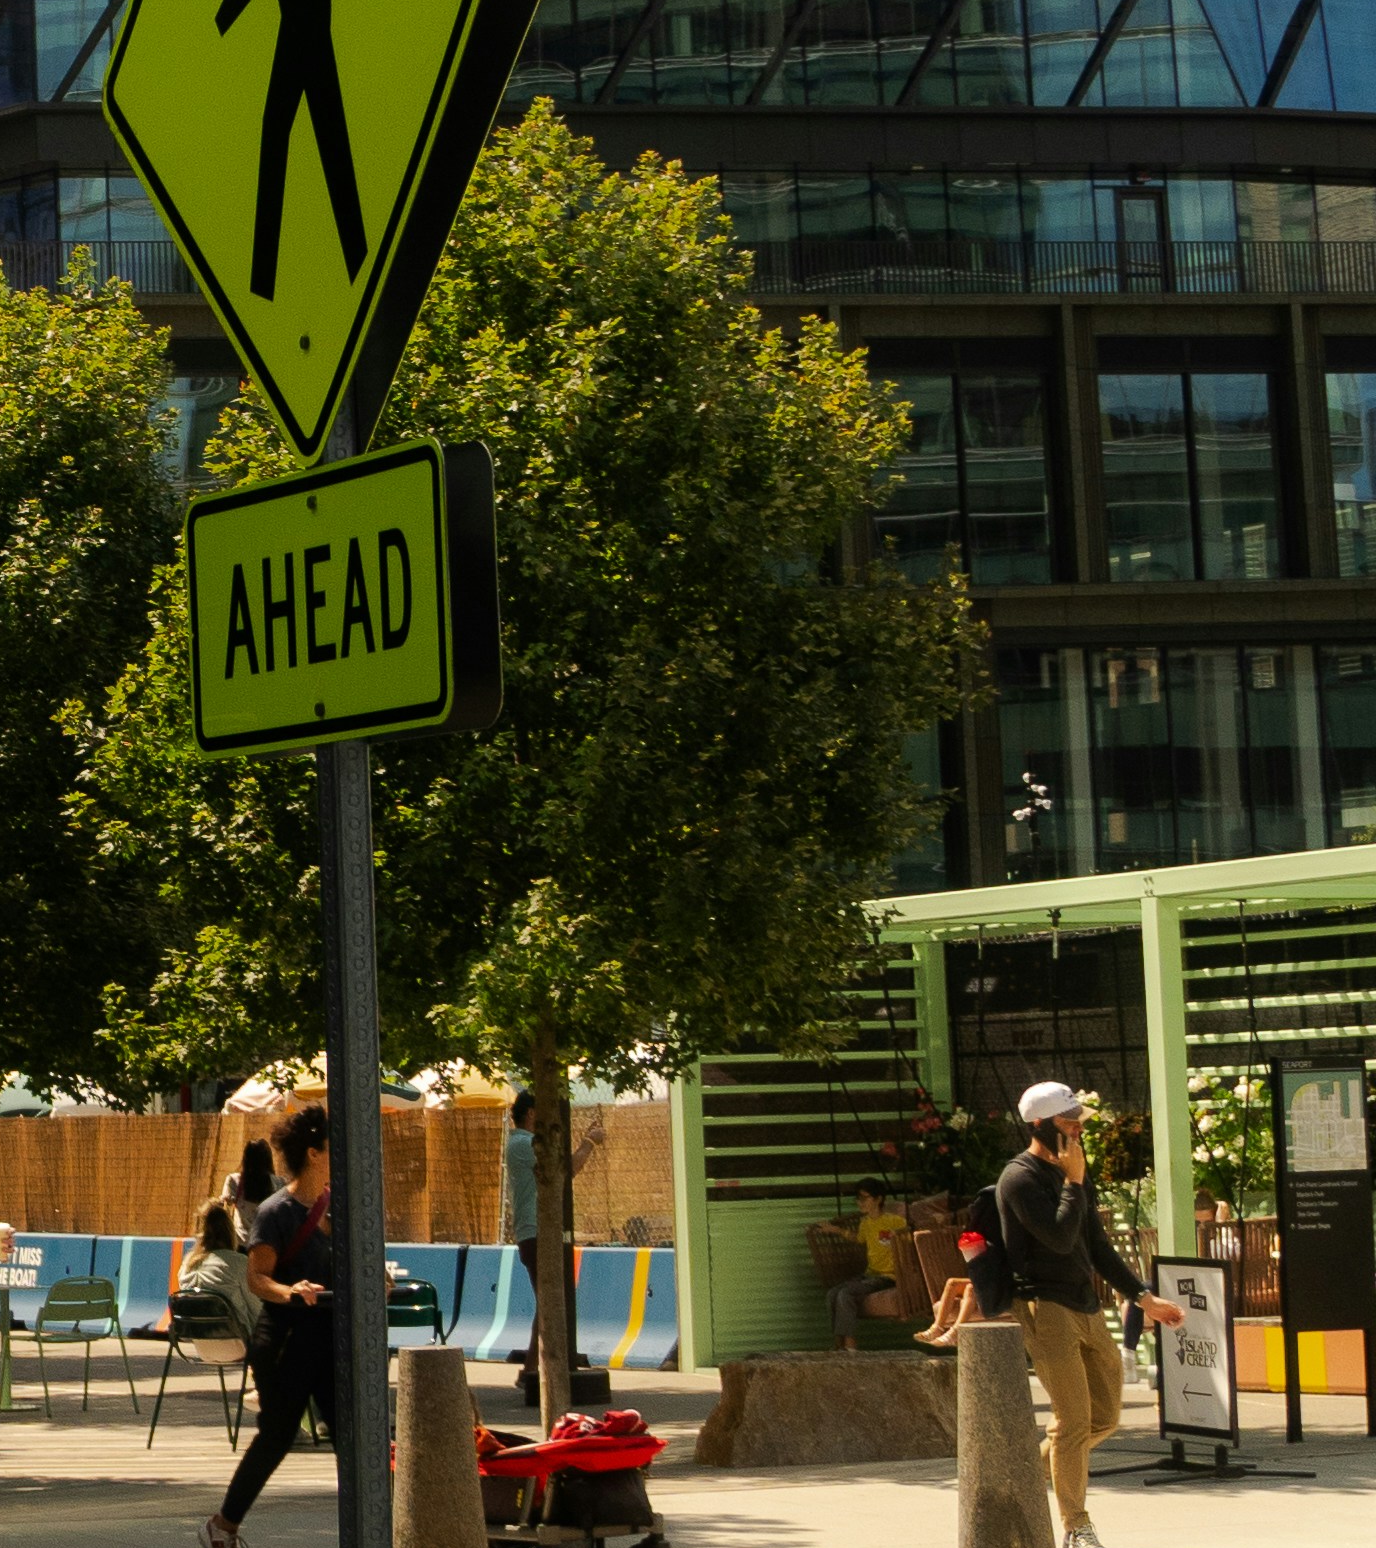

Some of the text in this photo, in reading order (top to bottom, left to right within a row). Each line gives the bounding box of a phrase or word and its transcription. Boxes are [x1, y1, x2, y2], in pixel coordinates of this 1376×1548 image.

[225, 527, 412, 680] AHEAD
[1282, 1060, 1312, 1069] SEAPORT
[19, 1247, 42, 1266] MISS
[9, 1268, 37, 1287] BOAT!
[1185, 1339, 1217, 1355] ISLAND
[1186, 1353, 1217, 1368] CREEK
